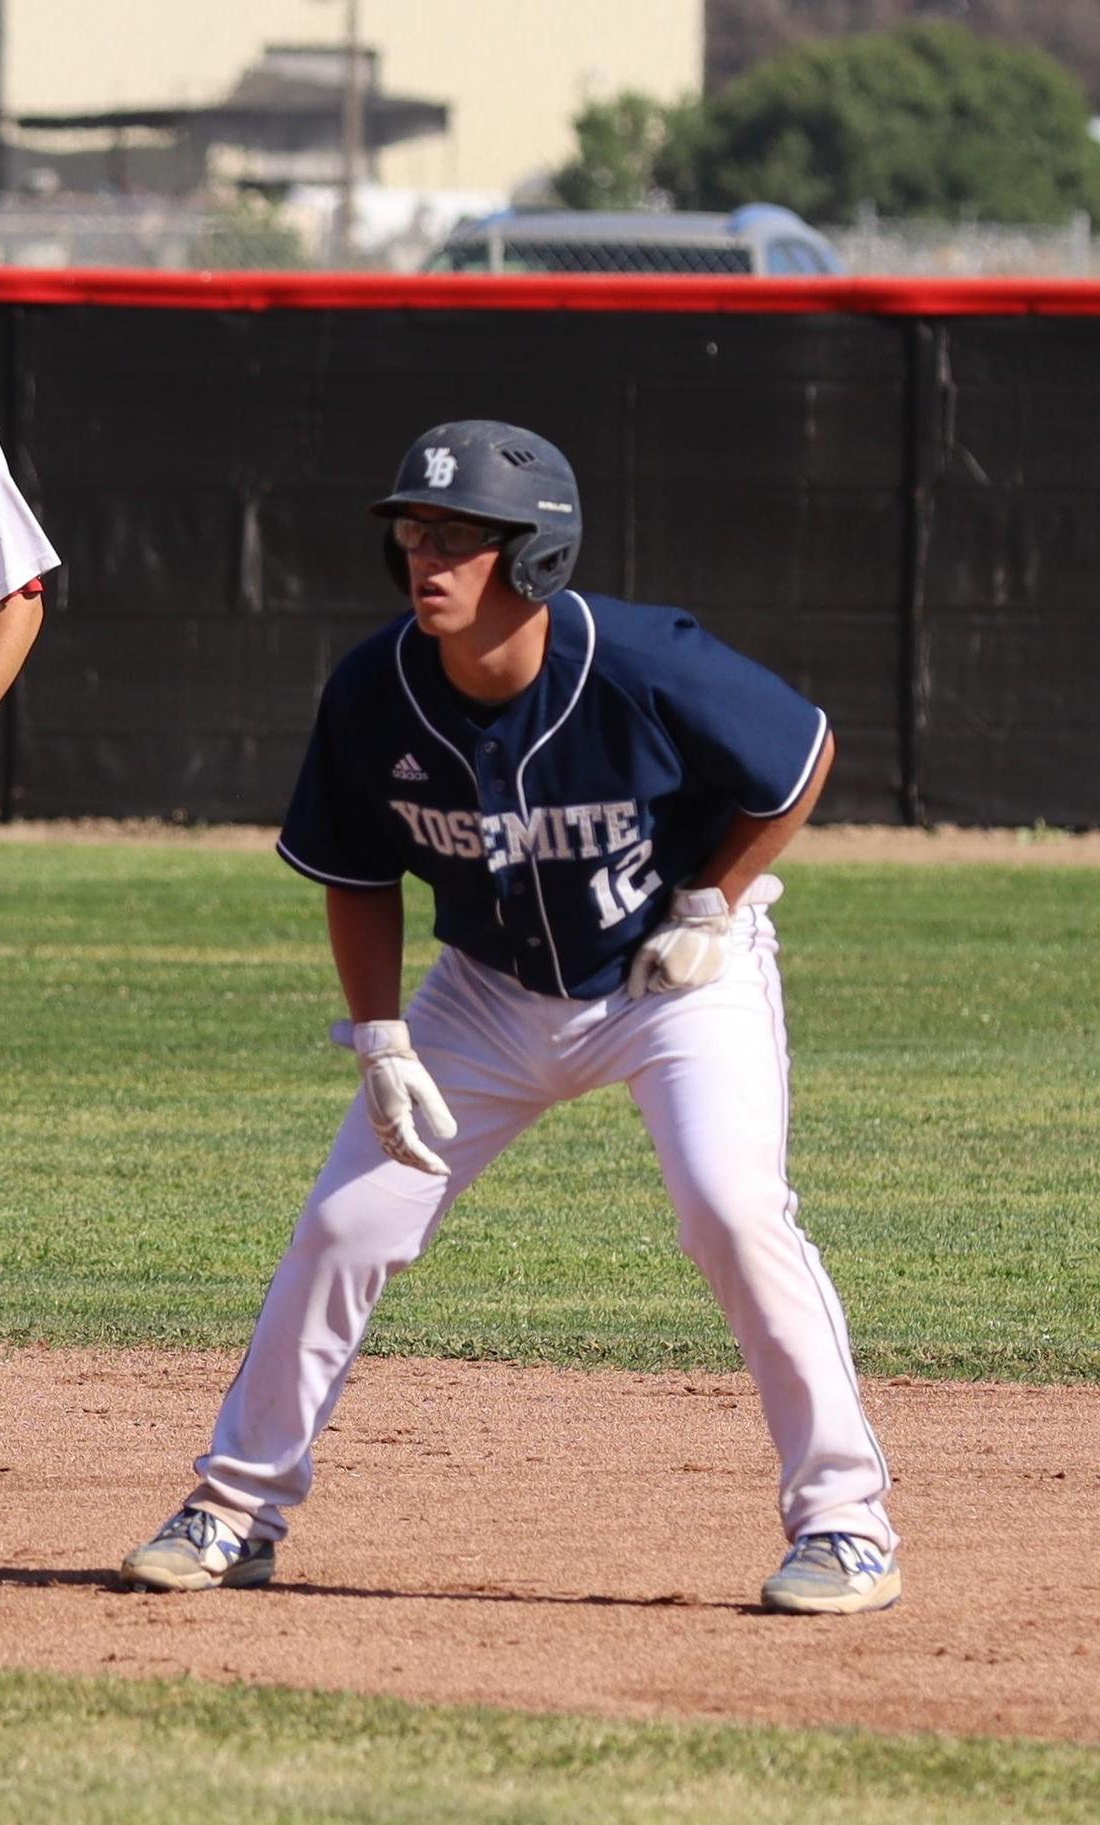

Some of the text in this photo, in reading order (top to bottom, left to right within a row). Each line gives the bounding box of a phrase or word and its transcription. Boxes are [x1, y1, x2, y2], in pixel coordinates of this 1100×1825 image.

[392, 769, 429, 781] adidas
[387, 799, 641, 873] YOSEMITE
[589, 839, 664, 930] 12
